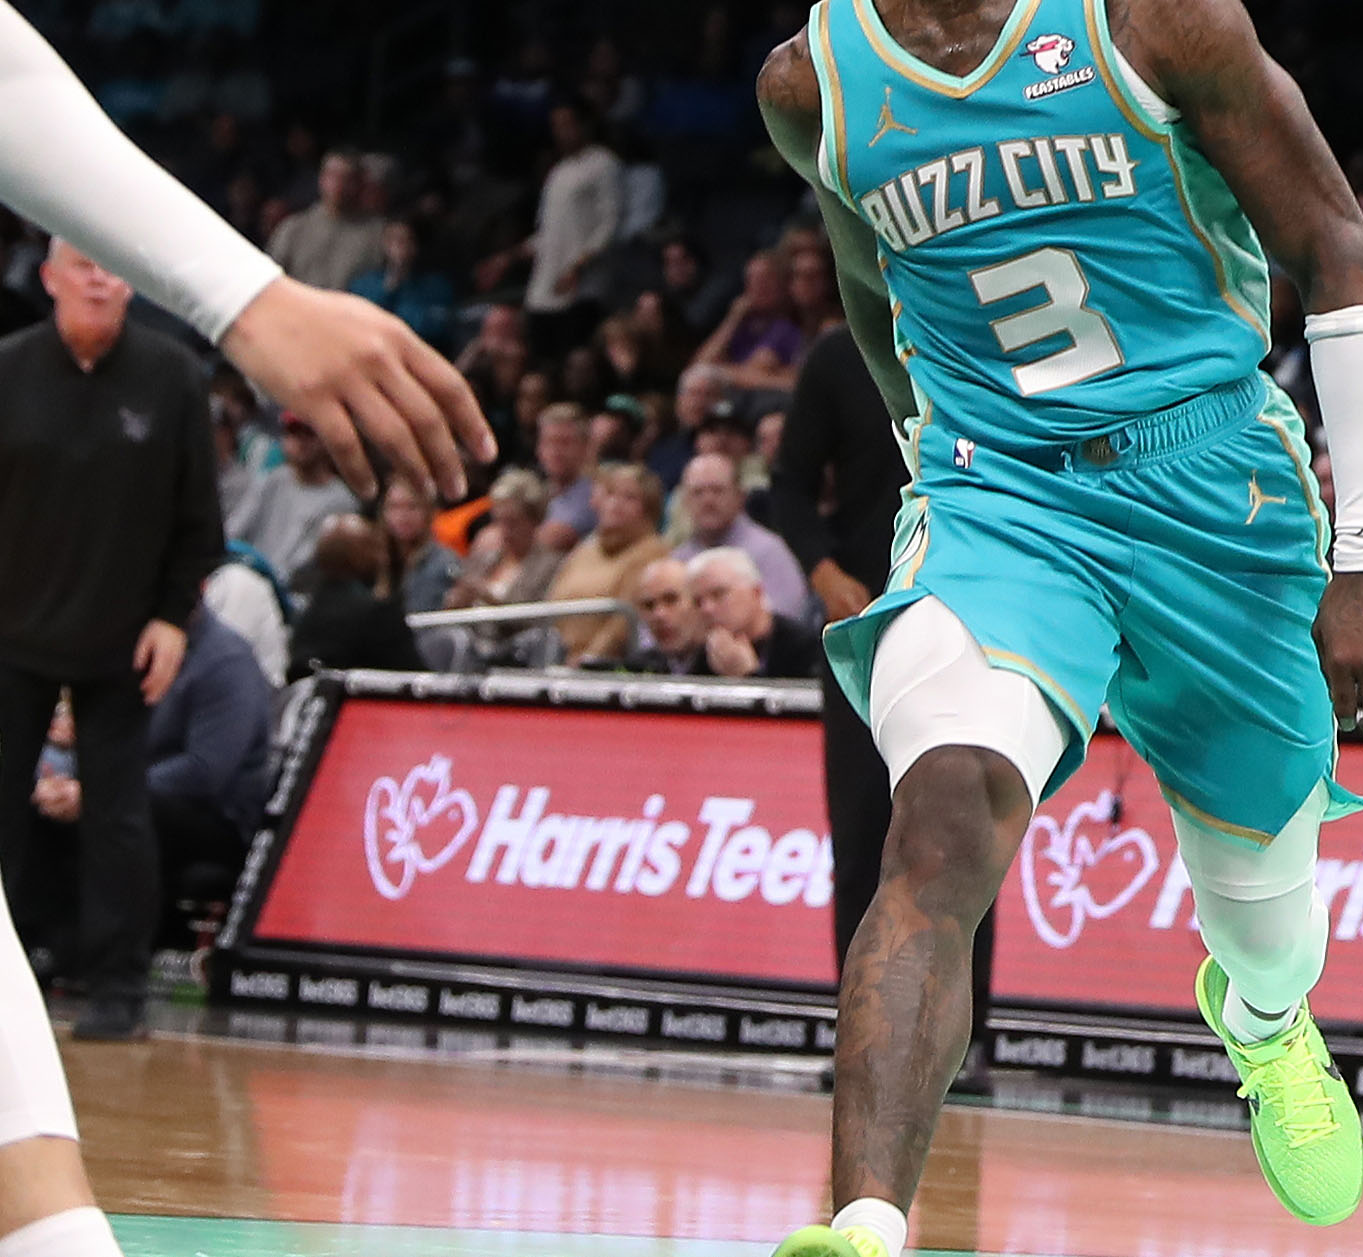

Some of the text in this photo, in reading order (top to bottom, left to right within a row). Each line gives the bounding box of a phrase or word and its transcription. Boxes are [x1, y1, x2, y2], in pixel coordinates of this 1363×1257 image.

[1024, 66, 1095, 99] FEASTABLES
[861, 134, 1140, 251] BUZZ CITY
[967, 247, 1126, 396] 3
[465, 784, 690, 896] Harris
